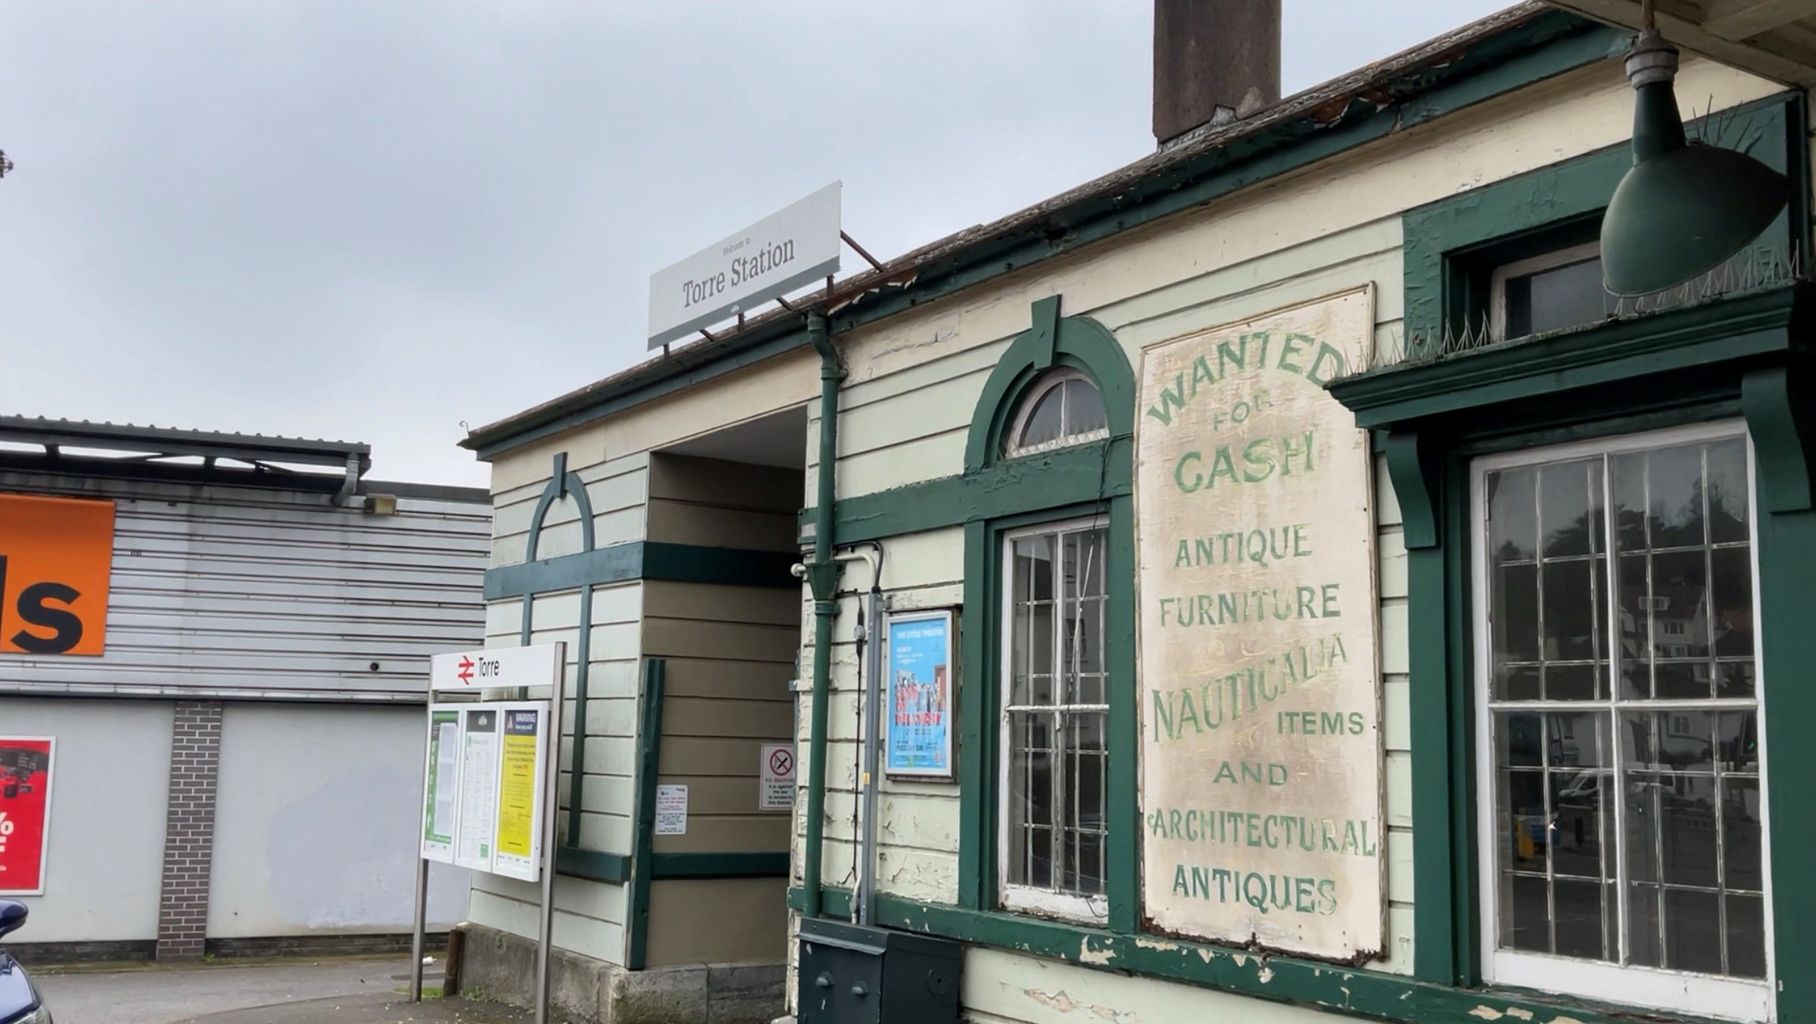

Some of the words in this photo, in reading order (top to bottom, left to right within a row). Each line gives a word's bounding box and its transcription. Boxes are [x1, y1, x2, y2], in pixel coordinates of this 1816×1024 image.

[683, 271, 725, 308] Torre
[731, 238, 795, 287] Station
[1146, 330, 1345, 427] WANTED
[1213, 390, 1273, 432] FOR
[1174, 430, 1315, 493] CASH
[1174, 523, 1313, 569] ANTIQUE
[1159, 583, 1341, 627] FURNITURE
[478, 657, 500, 677] Torre
[1152, 633, 1348, 742] NAUTICALIA
[1277, 711, 1365, 735] ITEMS
[1212, 761, 1288, 787] AND
[1147, 808, 1377, 857] ARCHITECTURAL
[1173, 864, 1337, 916] ANTIQUES
